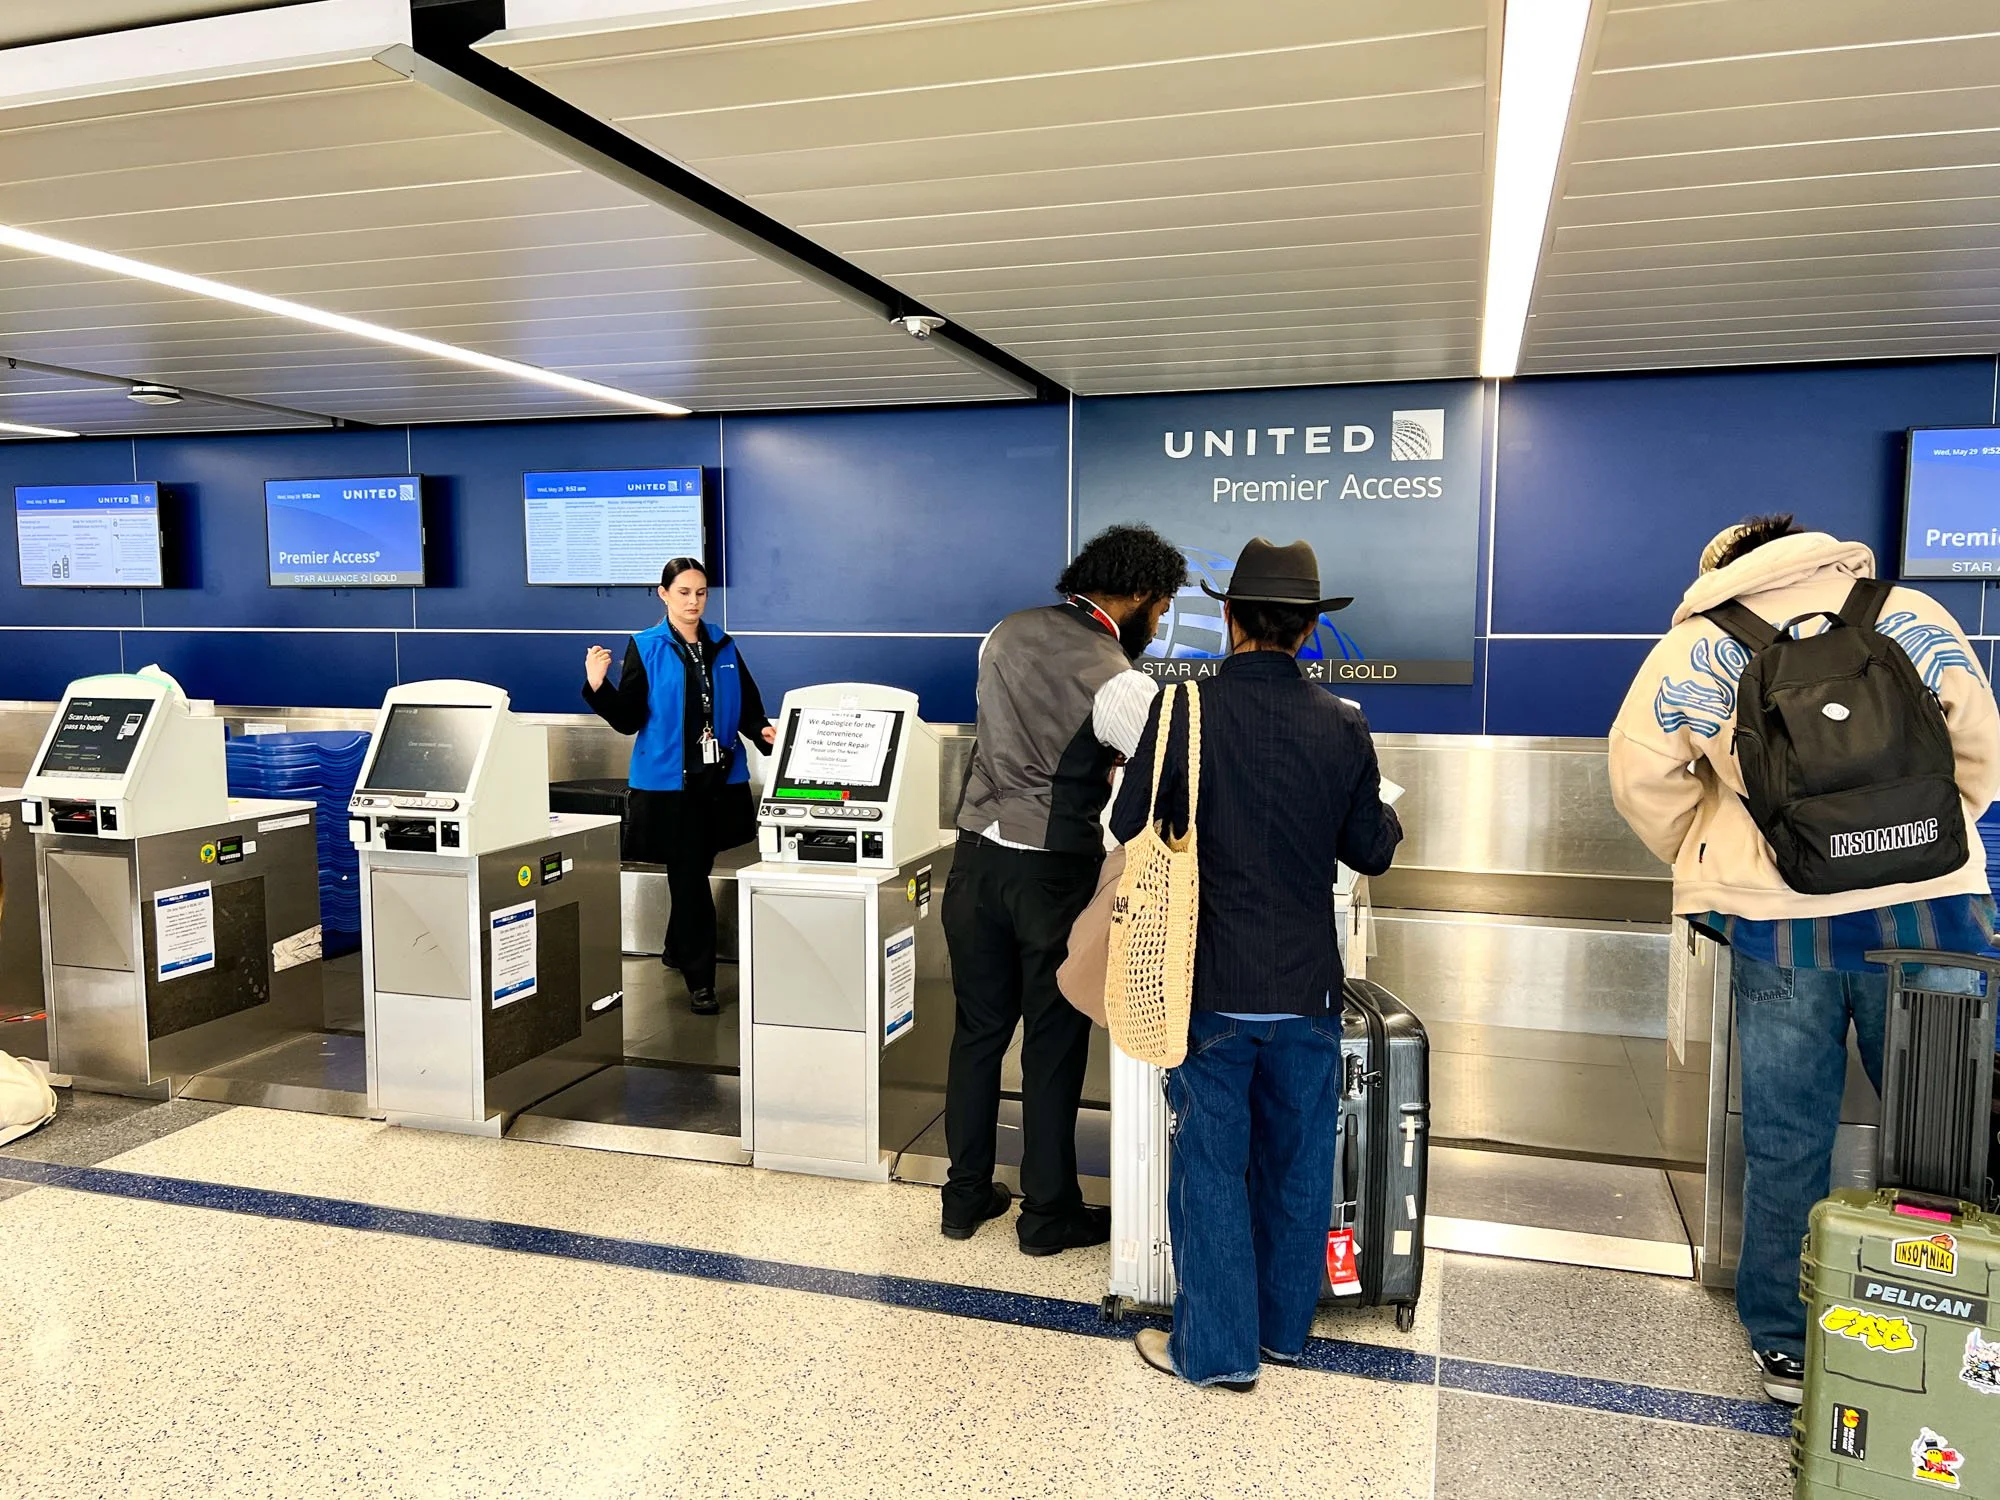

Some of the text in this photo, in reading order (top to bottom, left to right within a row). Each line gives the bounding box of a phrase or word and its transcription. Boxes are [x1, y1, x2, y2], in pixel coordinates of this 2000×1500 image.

[1164, 425, 1374, 458] UNITED
[627, 483, 666, 491] UNITED
[1213, 474, 1442, 502] Premier Access
[343, 489, 397, 499] UNITED
[1926, 528, 2000, 547] Premi
[279, 551, 329, 564] Premier
[1952, 562, 1992, 572] STAR
[294, 574, 397, 583] STAR ALLIANCE GOLD
[1142, 662, 1191, 676] STAR
[1339, 665, 1397, 679] GOLD
[83, 714, 110, 723] boarding
[821, 719, 853, 728] Apologize
[86, 724, 103, 732] begin
[848, 741, 870, 749] Repair
[1830, 817, 1938, 858] INSOMNIAC
[1898, 1243, 1950, 1270] INSOMNIAC
[1865, 1283, 1973, 1318] PELICAN
